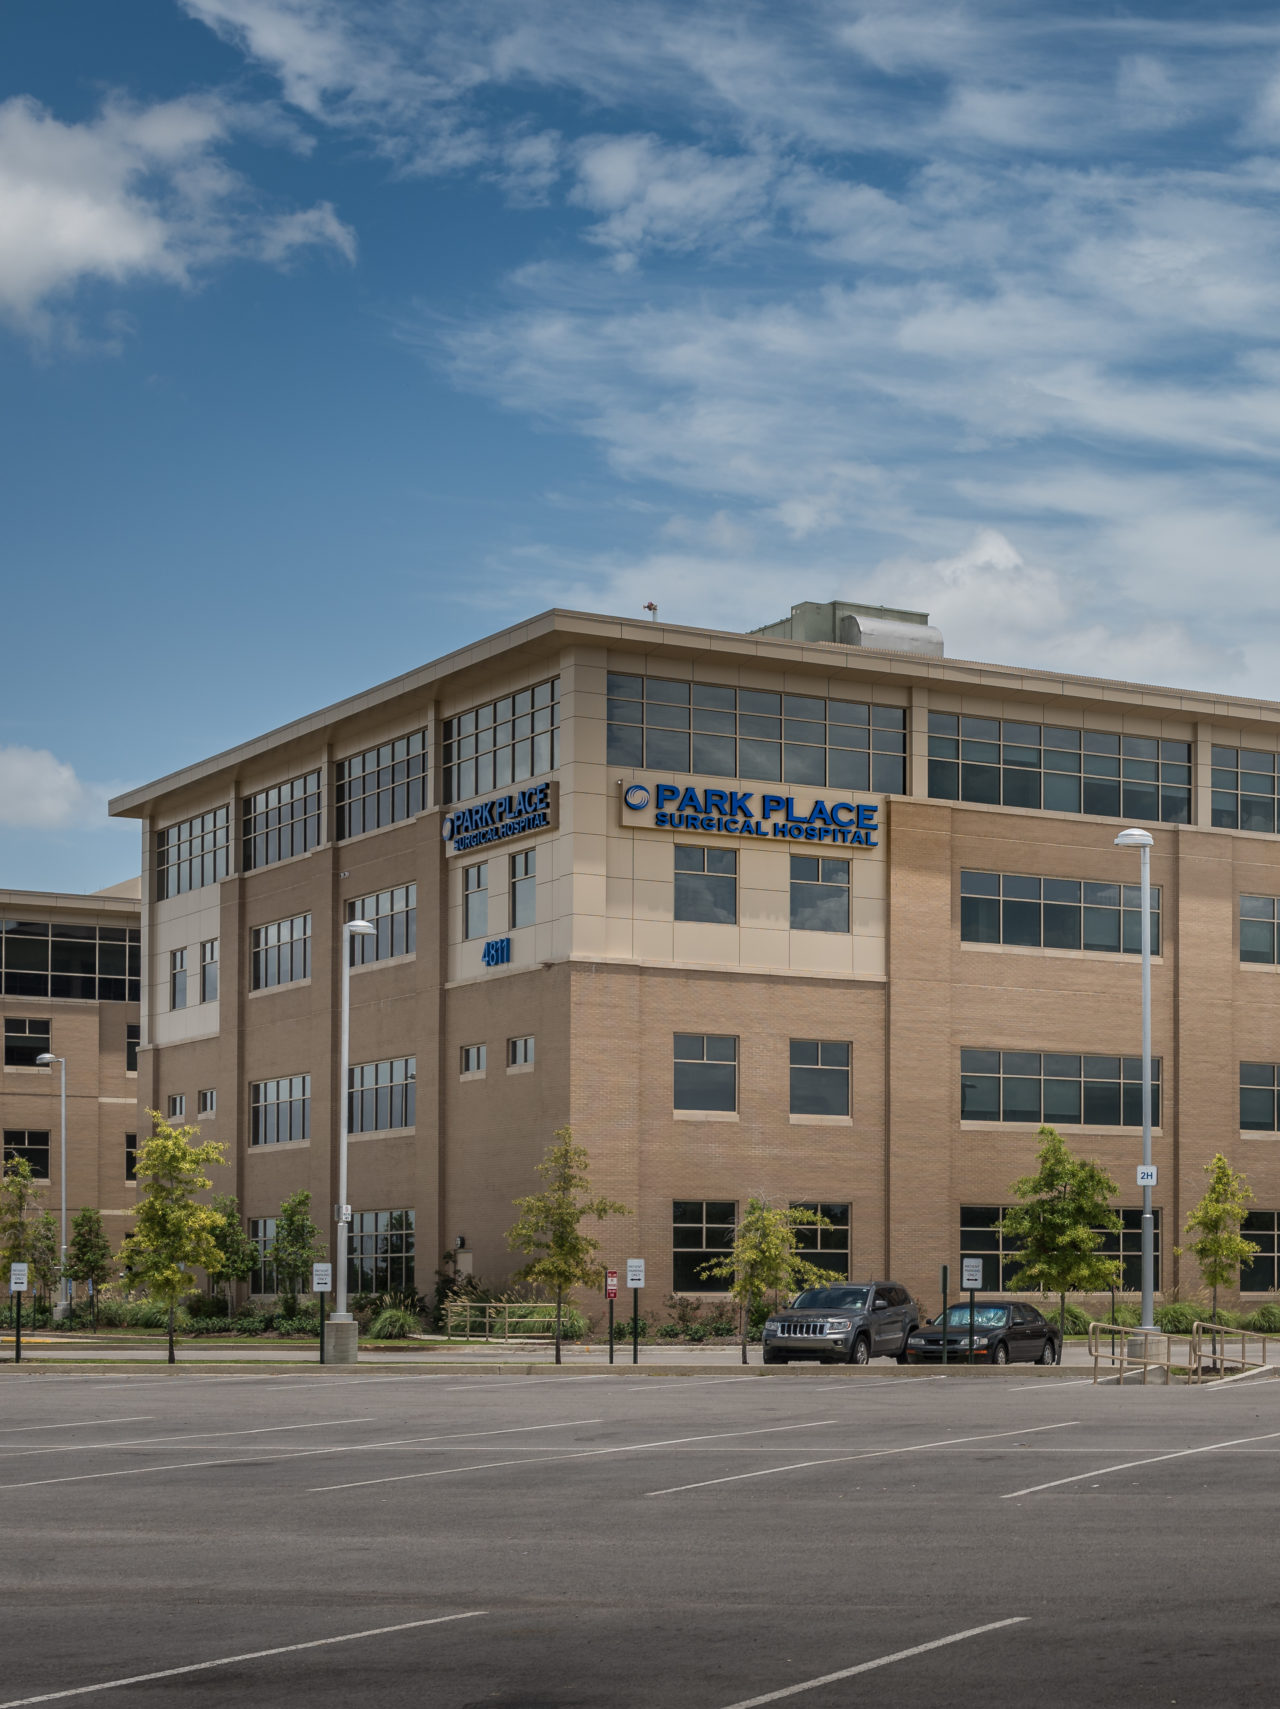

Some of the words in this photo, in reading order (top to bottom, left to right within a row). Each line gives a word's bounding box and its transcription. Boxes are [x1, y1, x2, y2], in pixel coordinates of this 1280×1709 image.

[454, 801, 495, 836] PARK
[496, 782, 549, 823] PLACE
[656, 783, 755, 818] PARK
[762, 794, 879, 831] PLACE
[454, 826, 500, 851] SURGICAL
[500, 812, 550, 838] HOSPITAL
[655, 811, 769, 836] SURGICAL
[774, 821, 879, 846] HOSPITAL
[481, 937, 511, 967] 4811
[1140, 1171, 1153, 1180] 2H
